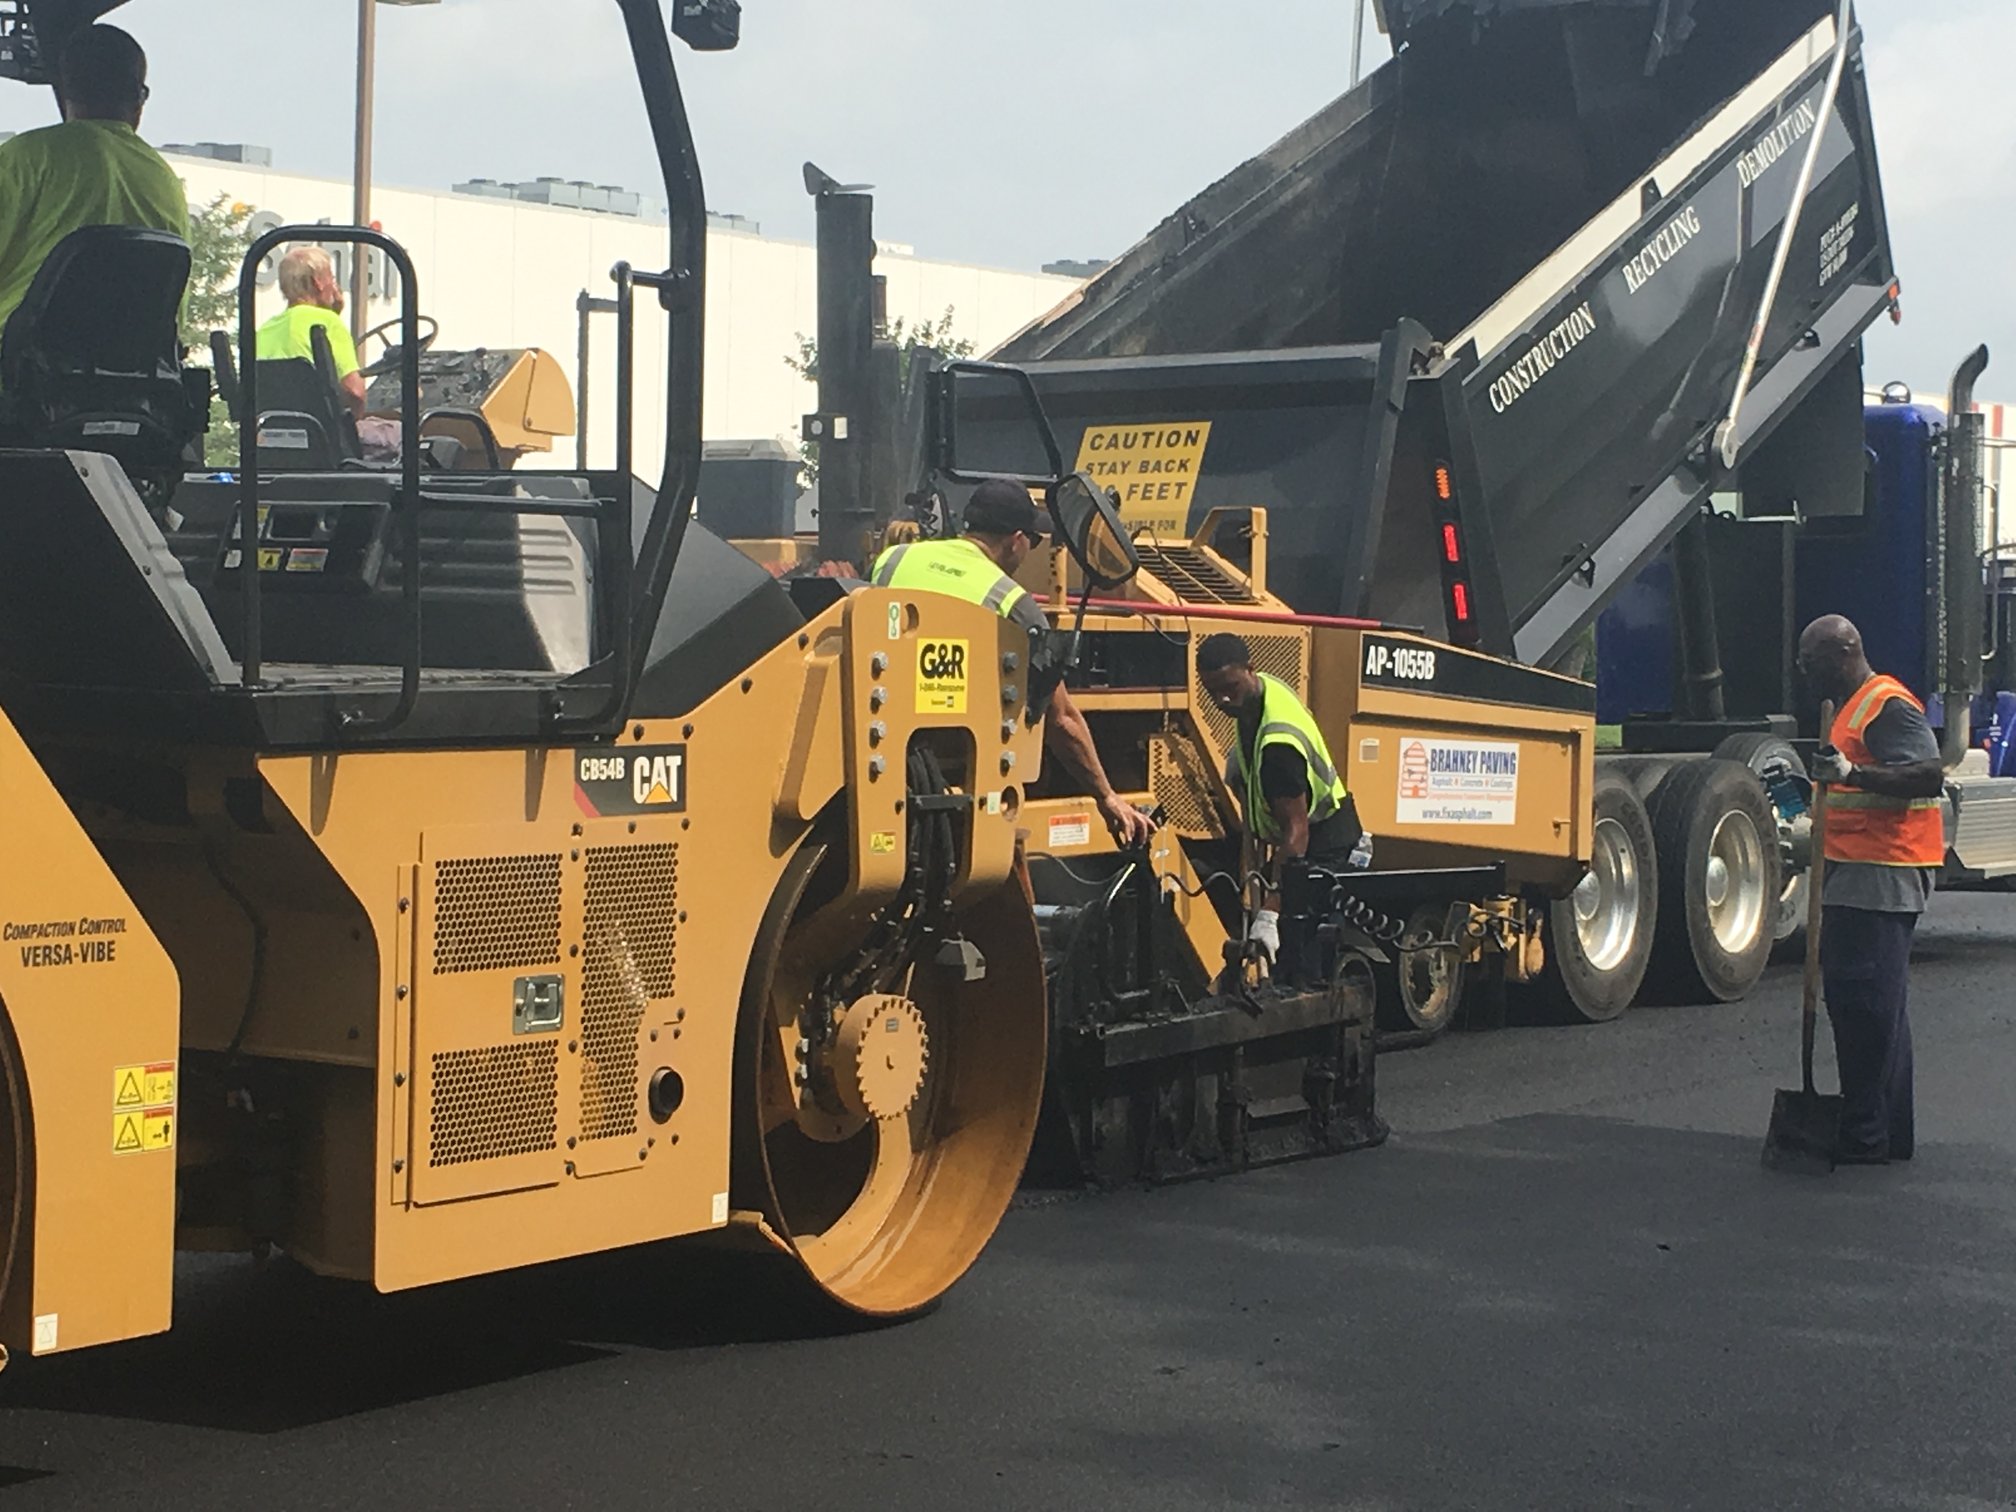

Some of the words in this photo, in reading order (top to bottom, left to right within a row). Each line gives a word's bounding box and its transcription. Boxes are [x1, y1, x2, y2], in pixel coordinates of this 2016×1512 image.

[1735, 98, 1815, 188] DEMOLITION
[1622, 206, 1701, 295] RECYCLING
[1489, 301, 1596, 413] CONSTRUCTION
[1089, 430, 1200, 451] CAUTION
[1085, 461, 1131, 476] STAY
[1138, 458, 1191, 473] BACK
[1126, 482, 1187, 501] FEET
[920, 643, 965, 680] G&R
[1365, 645, 1435, 680] AP-1055B
[1430, 749, 1478, 773] BRAHNEY
[1480, 751, 1517, 774] PAVING
[581, 757, 625, 781] CB54B
[633, 755, 682, 804] CAT
[21, 940, 116, 967] VERSA-VIBE
